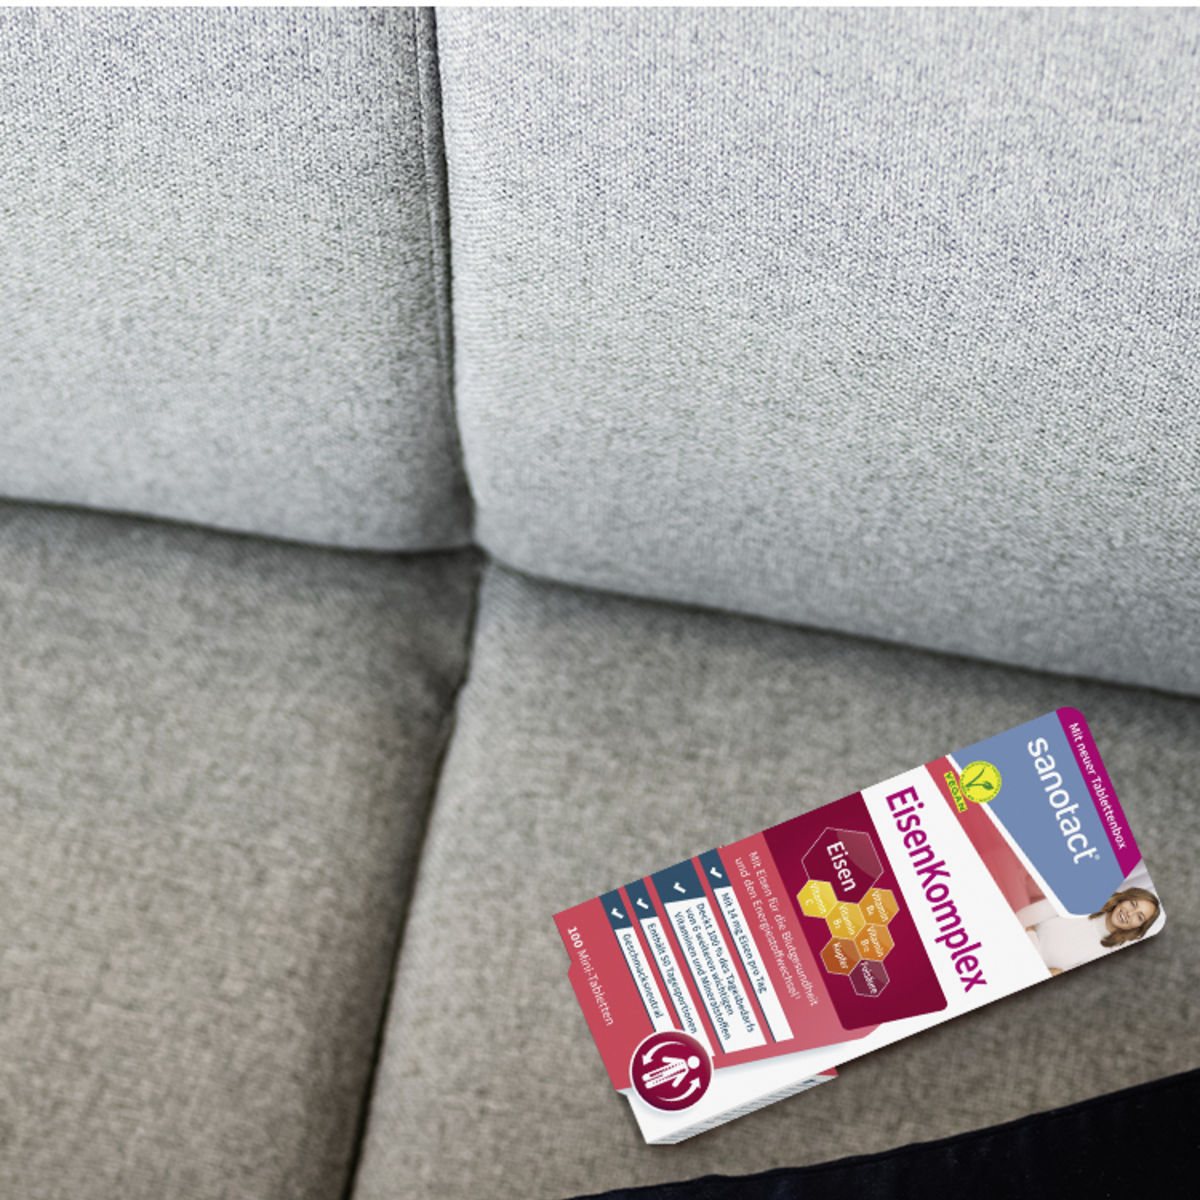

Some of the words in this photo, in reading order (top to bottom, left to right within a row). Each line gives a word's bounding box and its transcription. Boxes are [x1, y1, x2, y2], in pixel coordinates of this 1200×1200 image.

[1068, 722, 1083, 742] Mit
[1075, 742, 1096, 775] neuer
[943, 770, 968, 813] VEGAN
[1090, 774, 1126, 850] Tablettenbox
[734, 856, 751, 878] und
[825, 840, 856, 892] Eisen
[720, 891, 733, 908] Mit
[742, 878, 757, 900] den
[808, 881, 829, 914] Vitamin
[870, 888, 892, 922] Vitamin
[884, 785, 987, 993] EisenKomplex
[726, 907, 738, 919] 14
[731, 919, 743, 936] mg
[747, 850, 762, 869] Mit
[755, 868, 772, 897] Eisen
[767, 896, 779, 912] für
[773, 913, 786, 931] die
[780, 930, 818, 1007] Blutgesundheit
[838, 902, 858, 935] Vitamin
[737, 934, 753, 960] Eisen
[832, 940, 849, 969] Kupfer
[865, 924, 886, 958] Vitamin
[566, 925, 583, 948] 100
[576, 948, 614, 1026] Mini-Tabletten
[621, 932, 664, 1019] Geschmacksneutral
[673, 910, 697, 958] Vitaminen
[691, 957, 707, 977] und
[699, 975, 731, 1041] Mineralstoffen
[684, 906, 697, 926] von
[694, 931, 716, 972] weiteren
[710, 971, 734, 1016] wichtigen
[695, 901, 713, 931] Deckt
[717, 957, 730, 974] des
[725, 972, 756, 1033] Tagesbedarfs
[746, 959, 760, 976] pro
[646, 922, 666, 956] Enthält
[665, 965, 697, 1036] Tagesportionen
[755, 975, 767, 994] Tag
